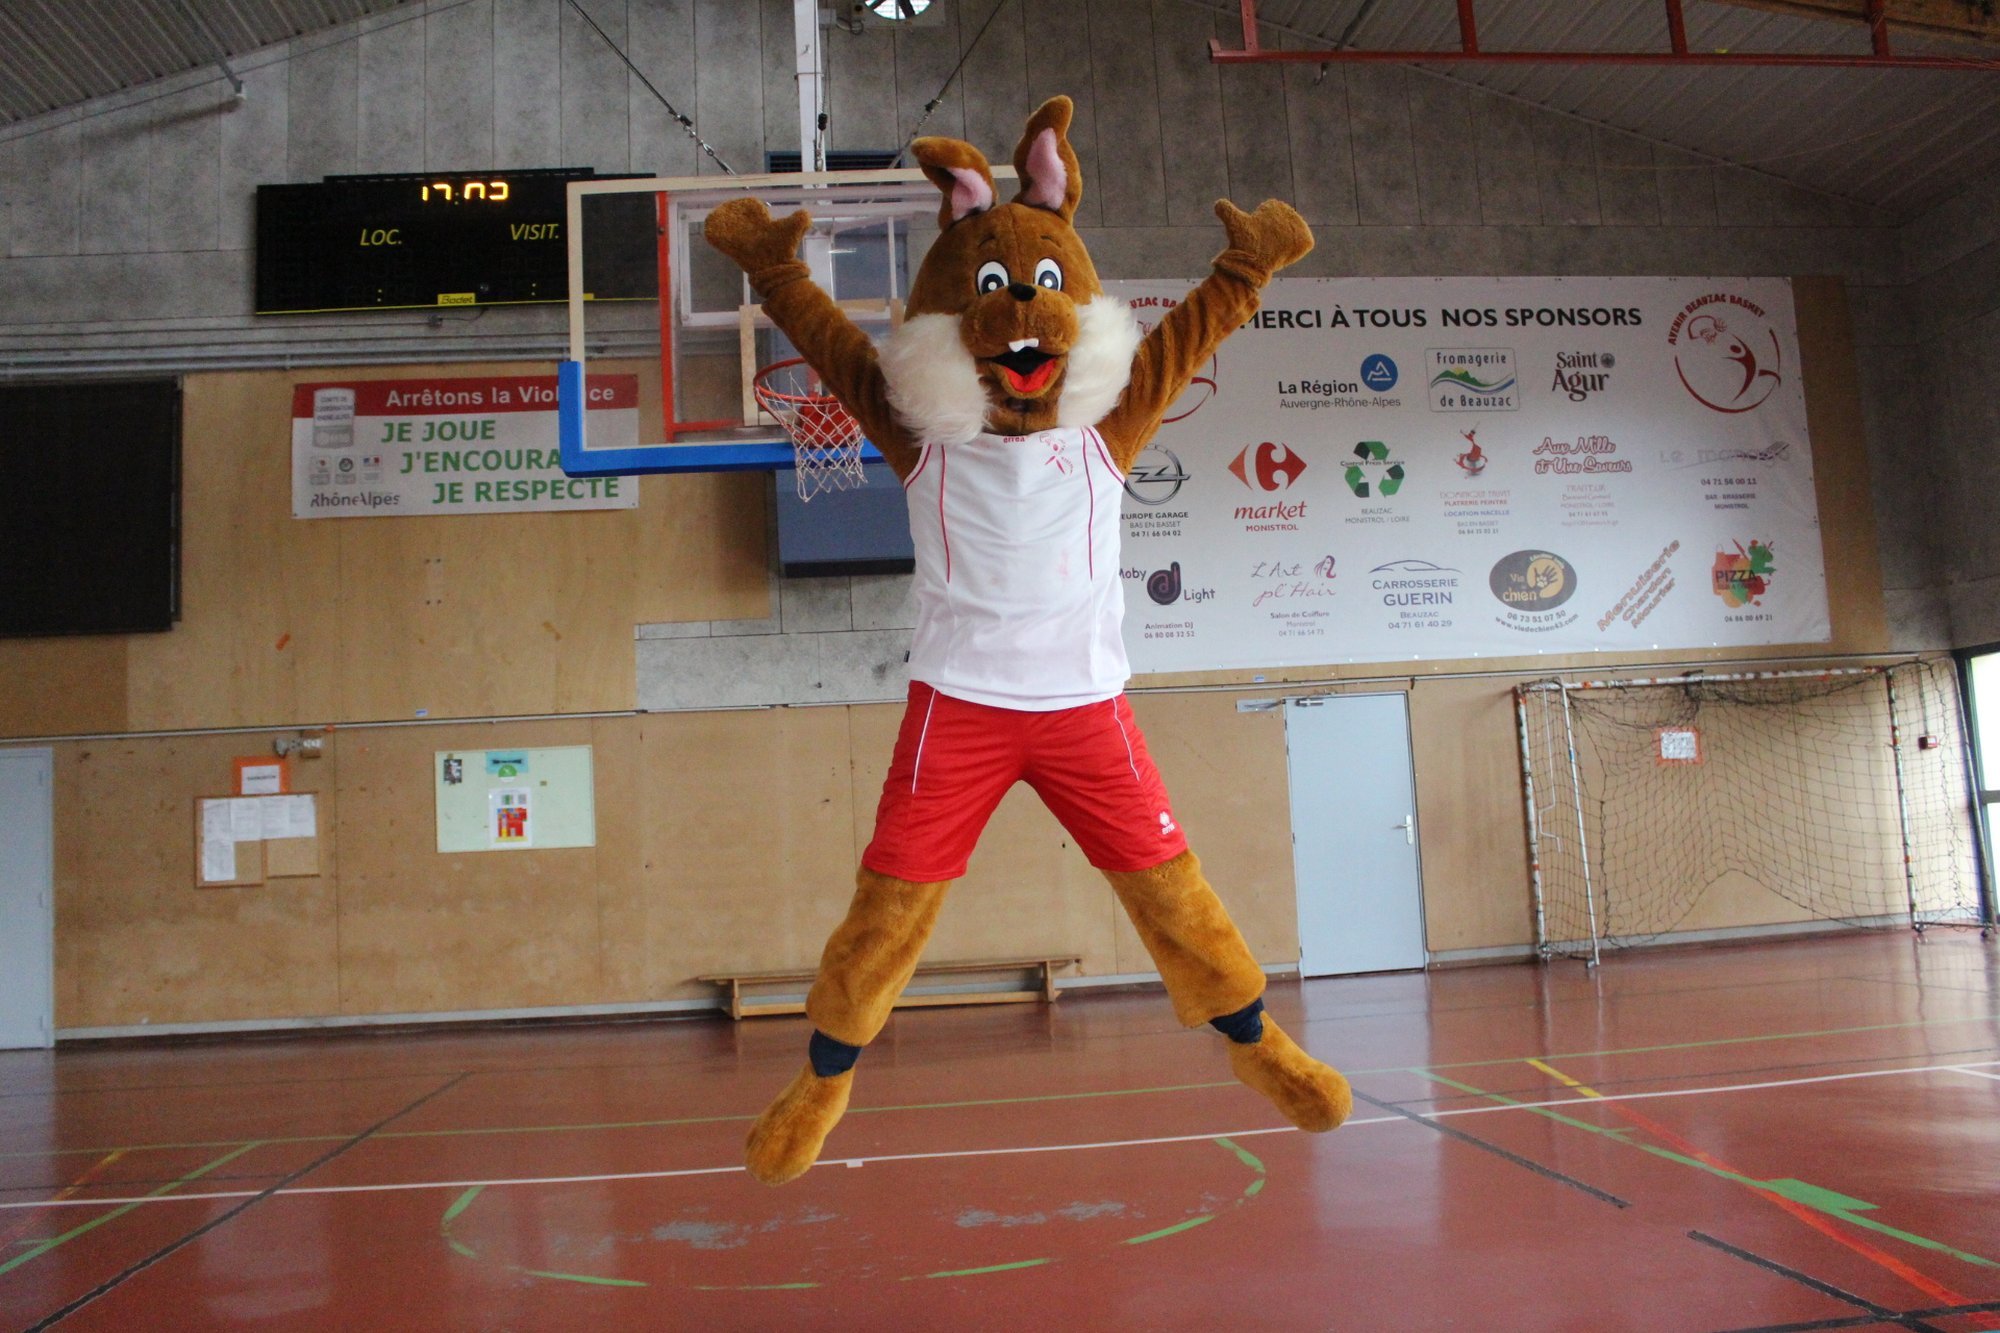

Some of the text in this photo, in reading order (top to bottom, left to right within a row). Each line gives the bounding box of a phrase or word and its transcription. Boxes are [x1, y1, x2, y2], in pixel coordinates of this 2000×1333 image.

[360, 229, 402, 246] LOC.
[510, 223, 559, 240] VISIT.
[1129, 296, 1158, 309] UZAC
[1685, 294, 1726, 314] BEAUZAC
[1331, 304, 1350, 328] À
[1353, 309, 1426, 328] TOUS
[1442, 309, 1498, 327] NOS
[1505, 308, 1642, 326] SPONSORS
[1437, 352, 1507, 367] Fromagerie
[1556, 352, 1598, 369] Saint
[1278, 380, 1358, 396] La Région
[1552, 369, 1610, 402] Agur
[386, 385, 615, 407] Arrêtons la Violce
[1280, 398, 1400, 409] Auvergne-Rhône-Alpes
[1440, 394, 1512, 407] de Beauzac
[381, 420, 496, 443] JE JOUE
[432, 477, 619, 504] JE RESPECTE
[1155, 511, 1189, 519] GARAGE
[1233, 501, 1307, 520] market
[1246, 524, 1298, 532] MONISTROL
[1716, 570, 1757, 582] PIZZA
[1372, 579, 1459, 590] CARROSSERIE
[1184, 588, 1216, 603] Light
[1383, 592, 1454, 606] GUERIN
